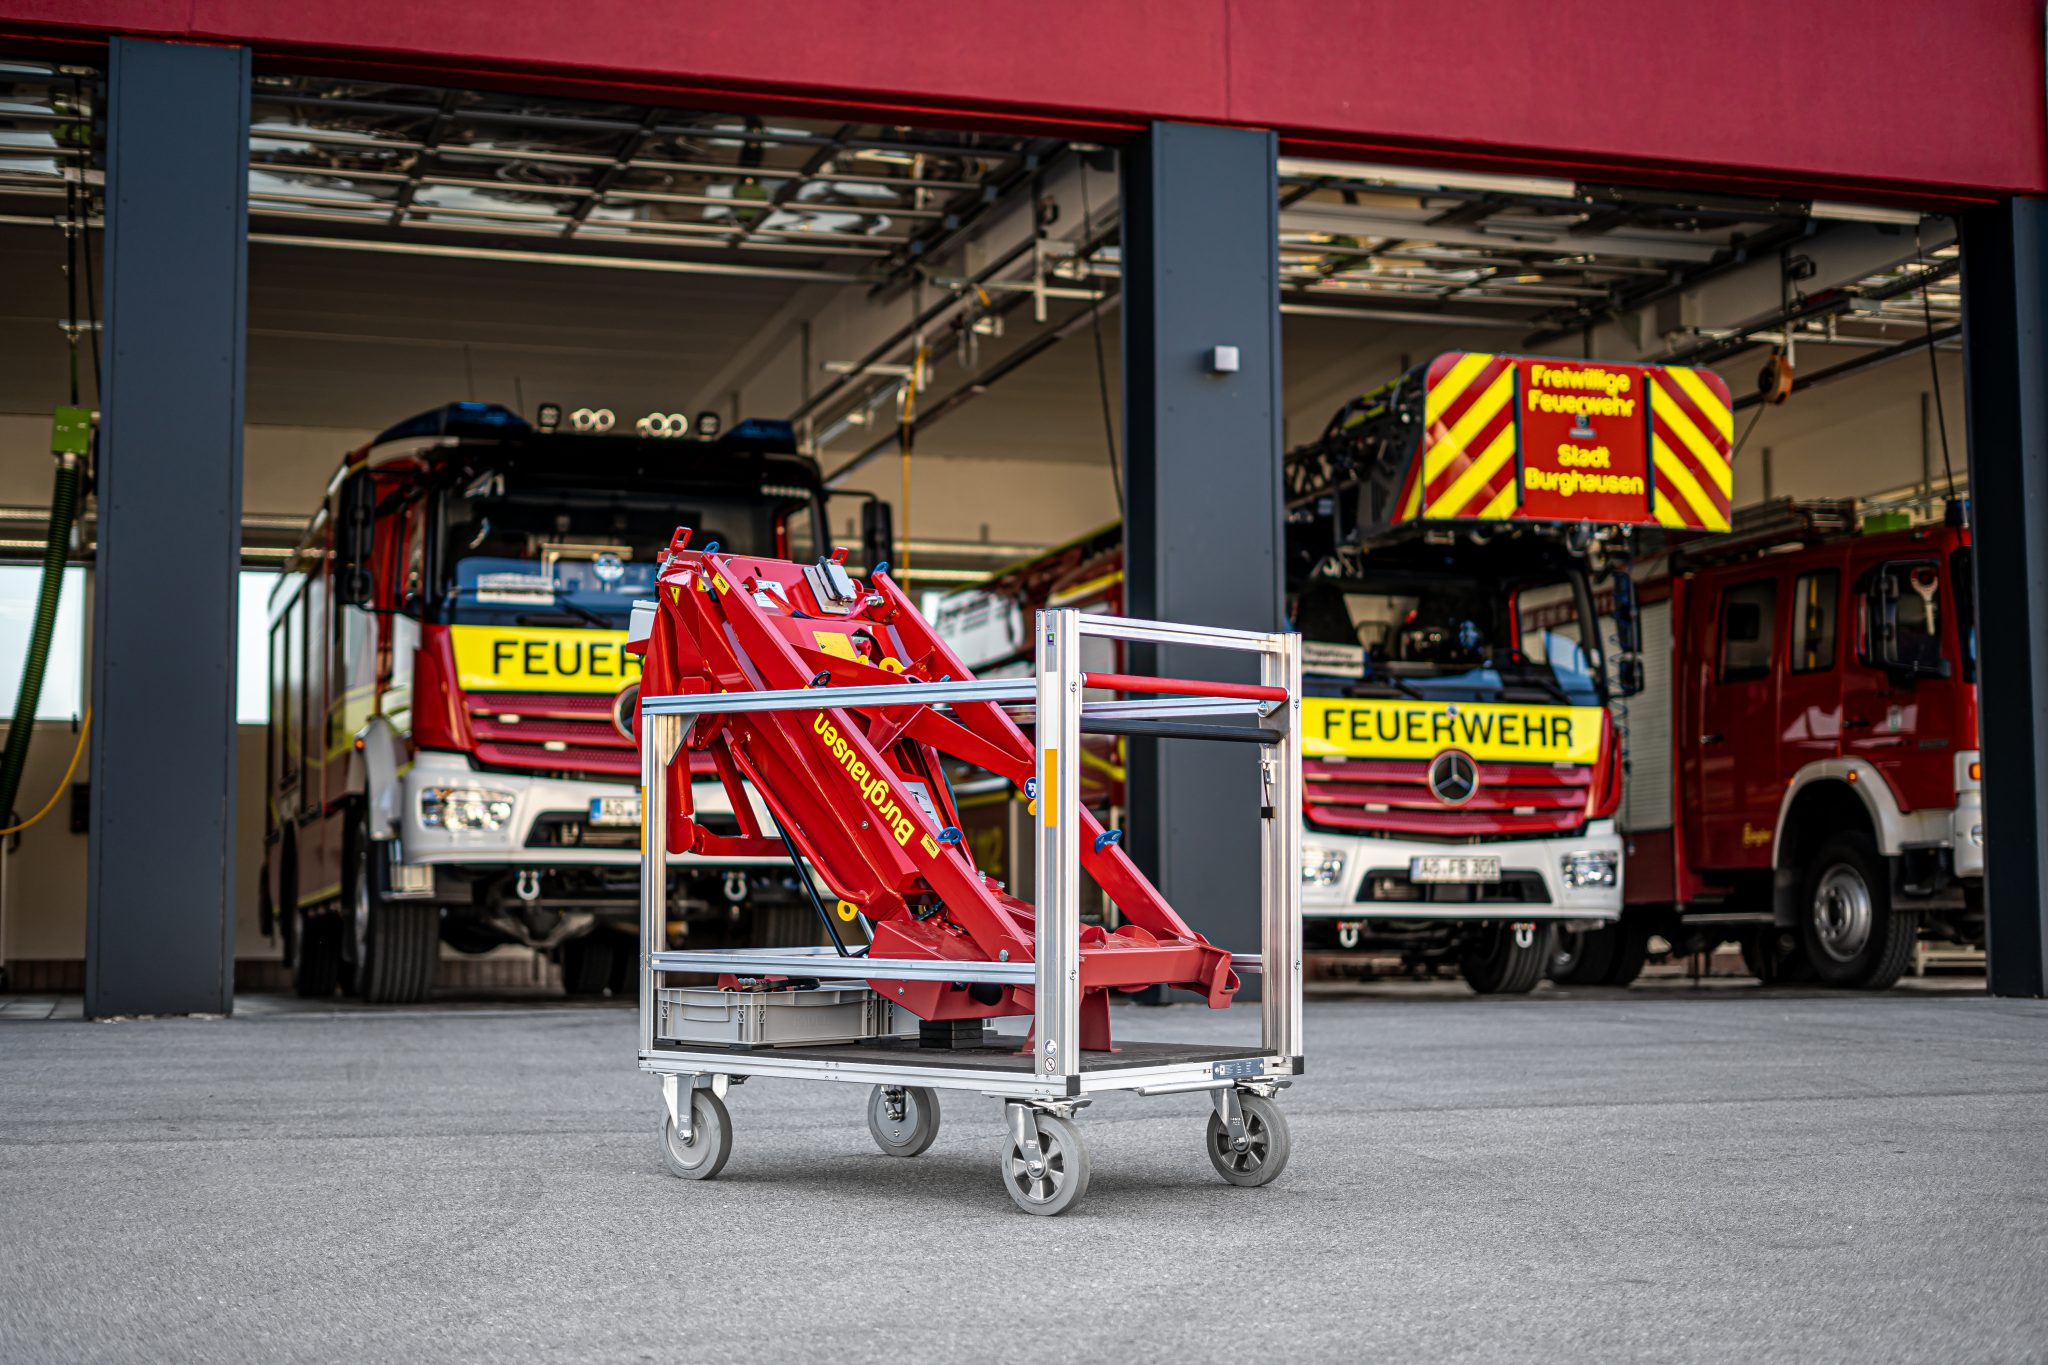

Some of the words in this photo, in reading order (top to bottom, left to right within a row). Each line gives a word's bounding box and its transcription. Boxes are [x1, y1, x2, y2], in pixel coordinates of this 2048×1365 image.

[1531, 364, 1631, 395] Freiwillige
[1528, 389, 1635, 417] Feuerwehr
[1557, 443, 1610, 469] Stadt
[1524, 466, 1644, 497] Burghausen
[1323, 708, 1574, 748] FEUERWEHR
[813, 712, 915, 847] Burghausen
